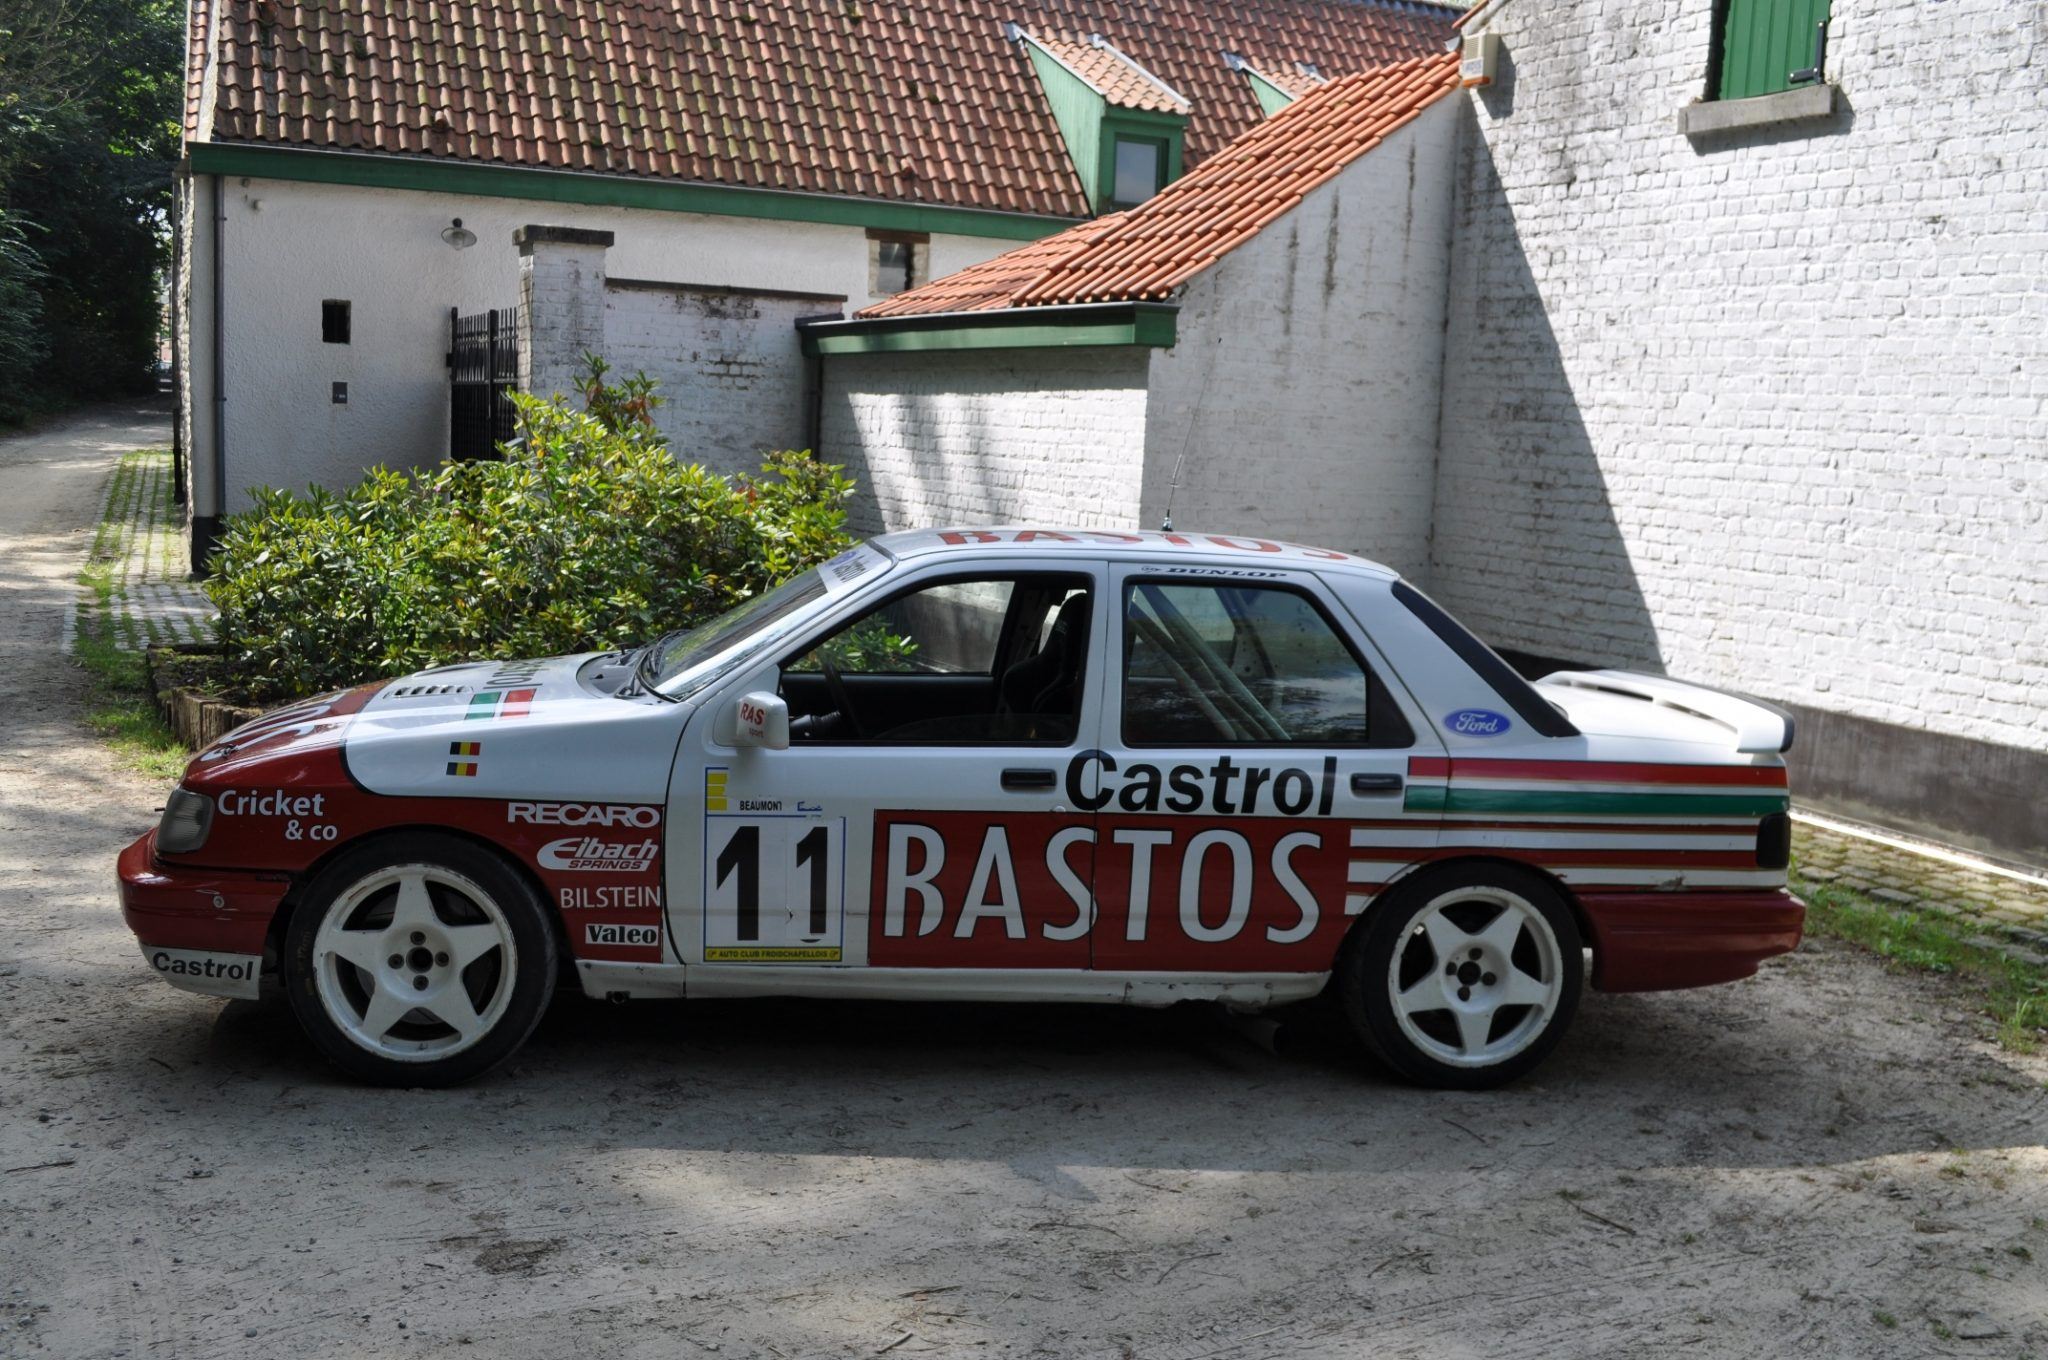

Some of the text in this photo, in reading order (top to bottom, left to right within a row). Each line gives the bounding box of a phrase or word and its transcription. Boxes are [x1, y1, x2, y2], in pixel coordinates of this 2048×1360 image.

[1167, 567, 1288, 578] DUNLOP
[740, 702, 765, 726] RAS
[1456, 712, 1498, 732] Ford
[1065, 748, 1338, 816] Castrol
[217, 789, 325, 817] Cricket
[507, 801, 661, 828] RECARO
[285, 819, 338, 841] & co
[536, 836, 659, 871] Eibach
[568, 859, 644, 870] SPRINGS
[883, 822, 1324, 944] BASTOS
[560, 886, 661, 909] BILSTEIN
[587, 924, 657, 944] Valeo
[718, 950, 739, 958] AUTO
[740, 950, 760, 958] CLUB
[152, 951, 254, 981] Castrol
